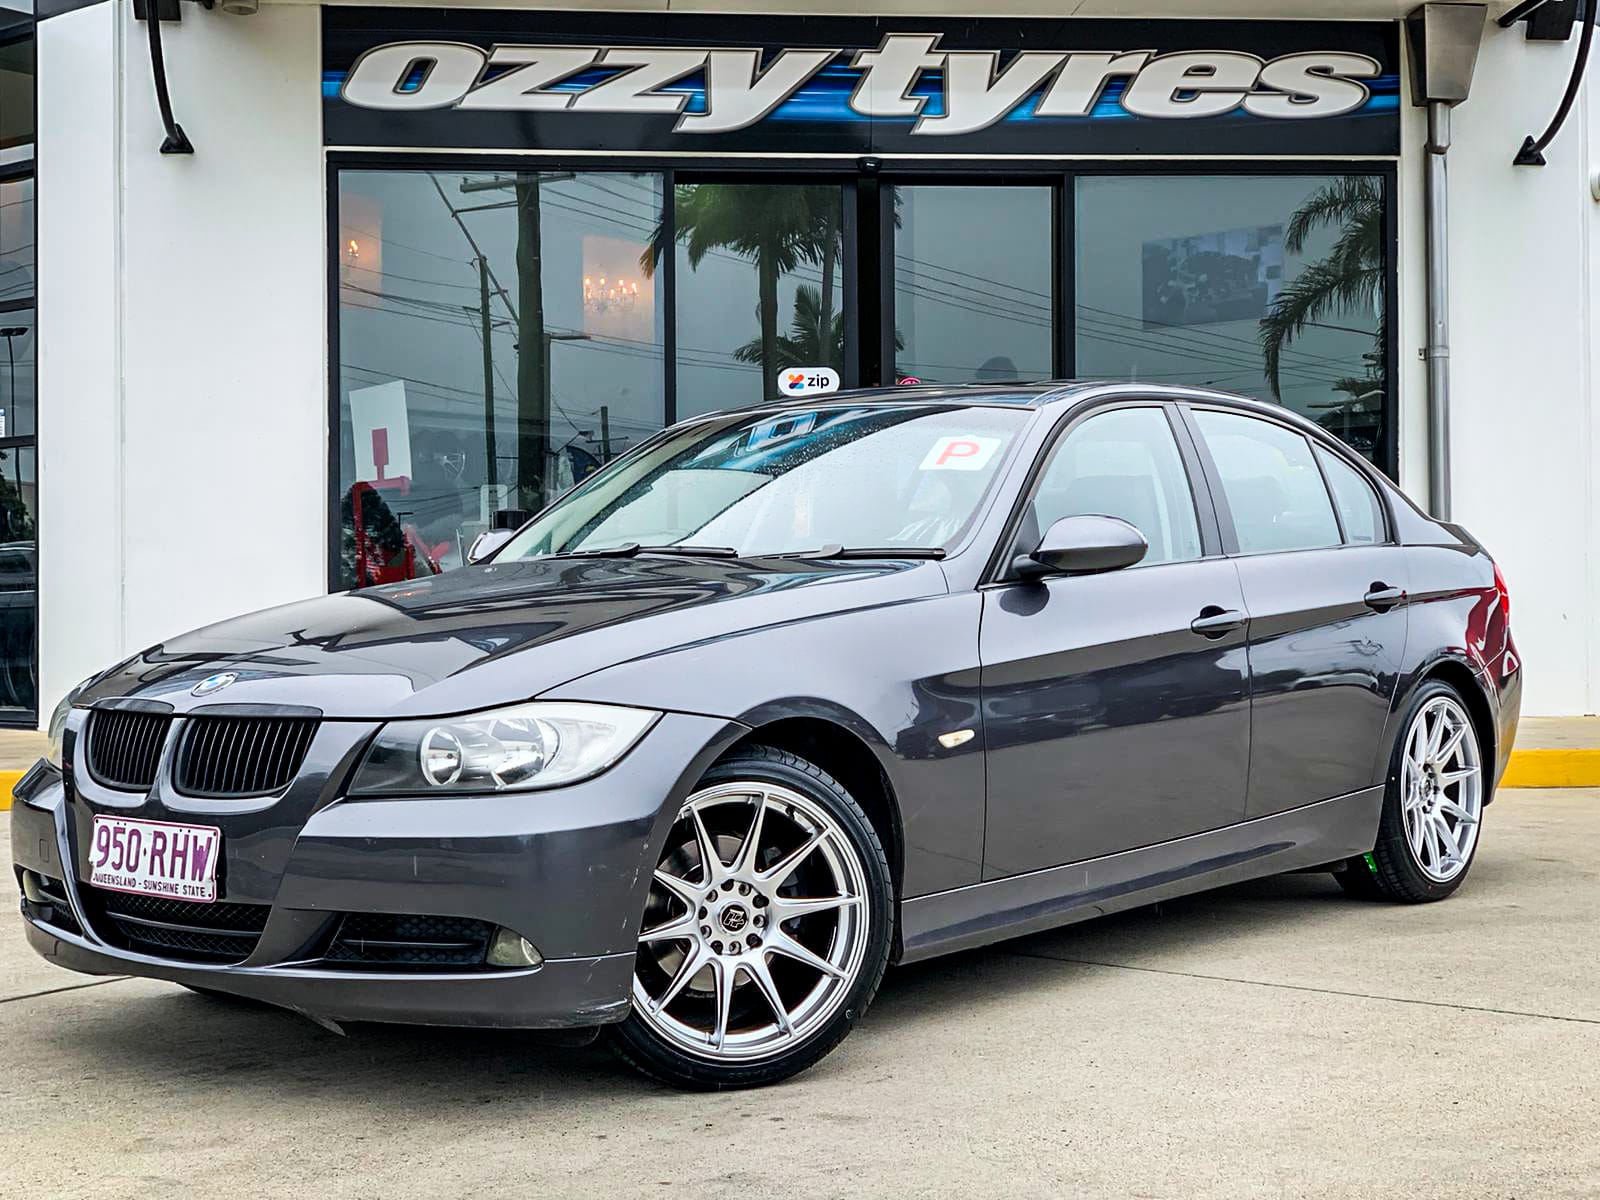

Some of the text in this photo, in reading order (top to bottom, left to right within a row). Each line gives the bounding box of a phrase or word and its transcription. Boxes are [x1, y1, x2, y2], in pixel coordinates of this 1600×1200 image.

[340, 32, 1381, 135] ozzy tyres
[807, 373, 830, 389] zip
[935, 441, 980, 465] P
[143, 880, 180, 894] SUNSHINE
[182, 885, 206, 897] STATE
